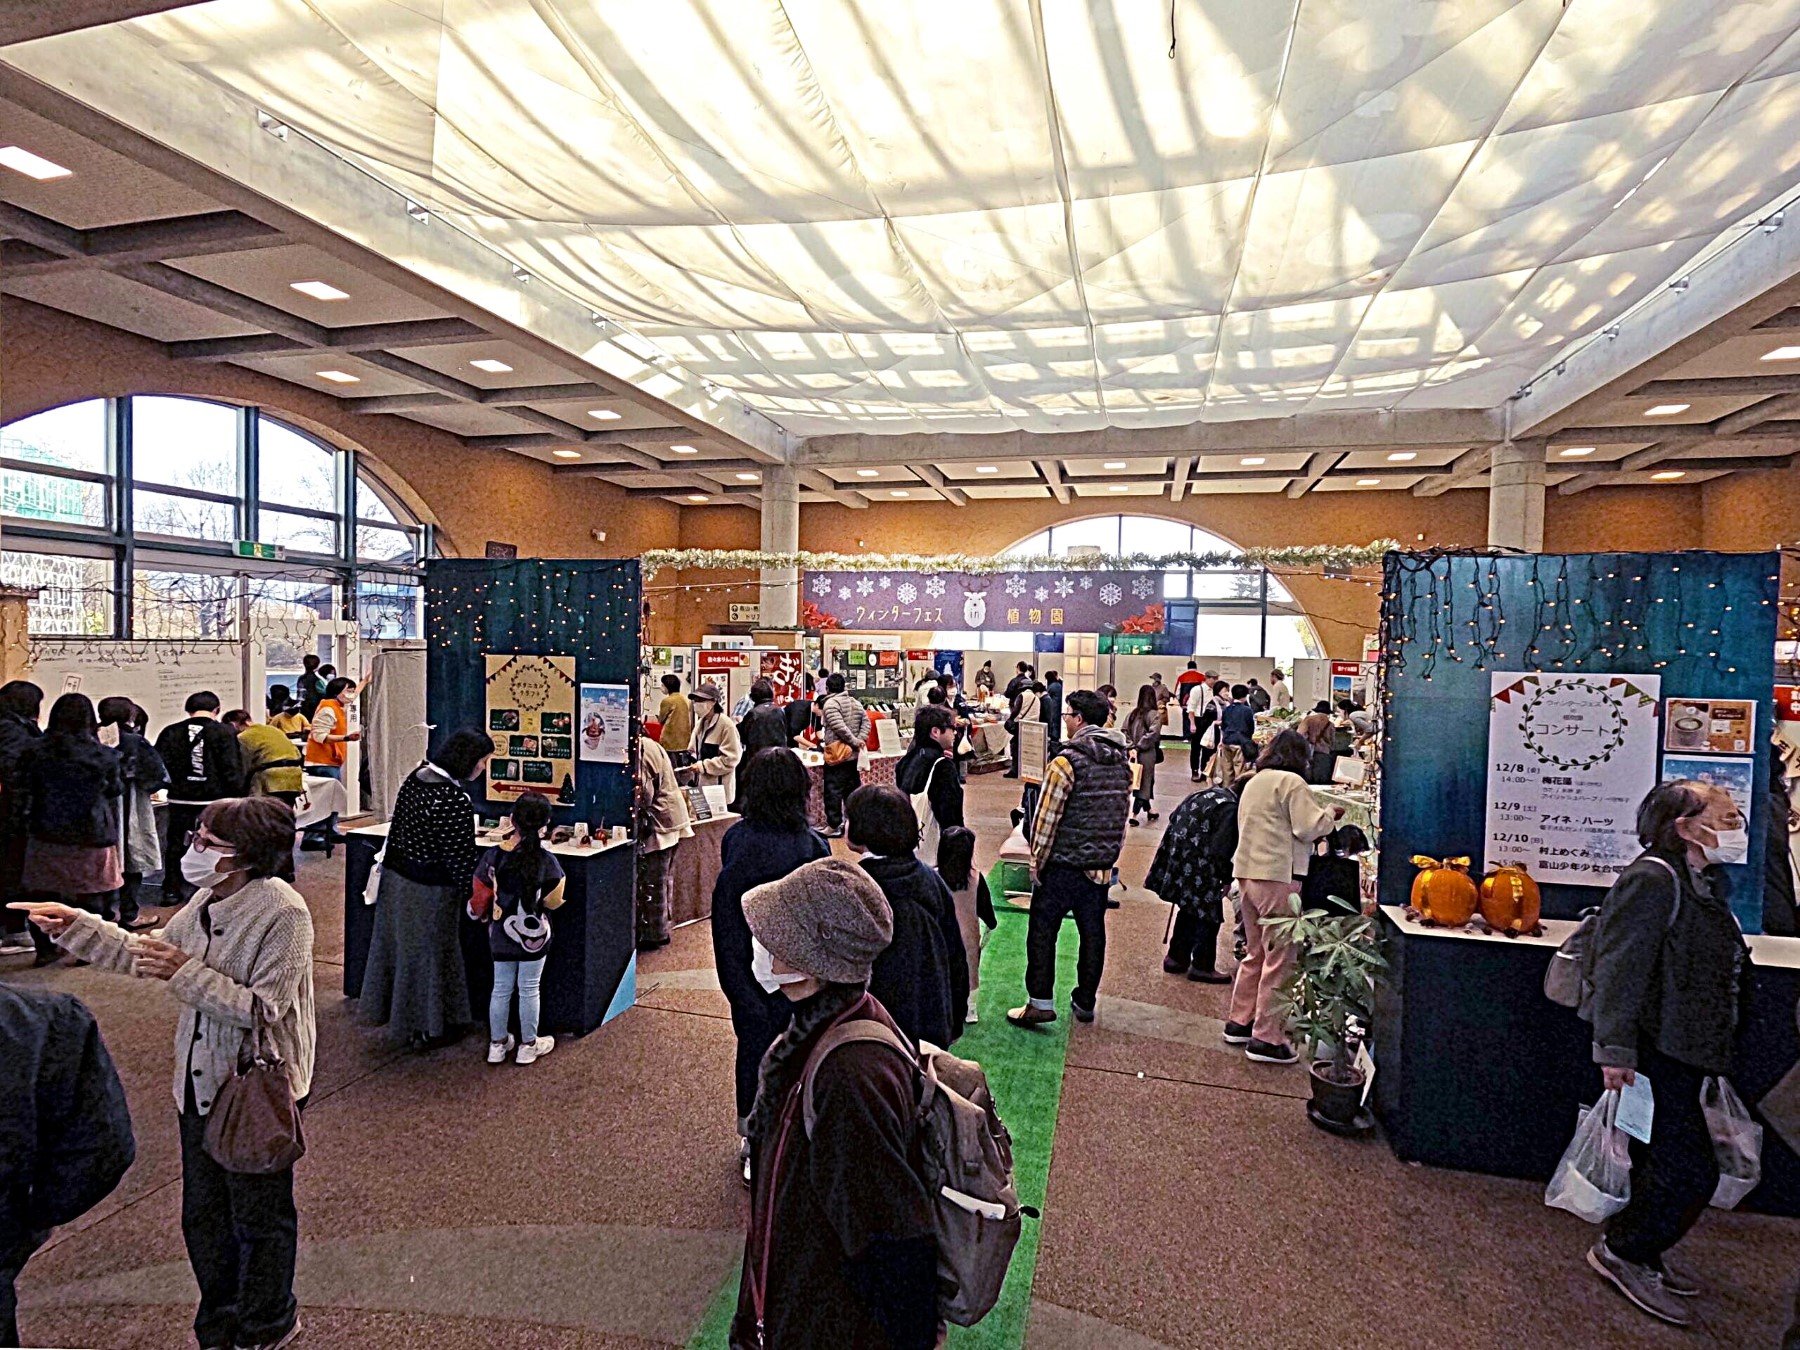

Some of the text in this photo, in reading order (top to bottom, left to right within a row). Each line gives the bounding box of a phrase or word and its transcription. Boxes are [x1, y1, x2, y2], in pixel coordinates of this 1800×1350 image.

[856, 605, 1064, 625] ウィンターフェス in 植物園
[1536, 724, 1610, 737] コンサート
[1495, 763, 1524, 772] 12/8
[1494, 802, 1520, 811] 12/9
[1540, 814, 1614, 826] アイネ・ハーツ
[1493, 833, 1529, 843] 12/10
[1539, 847, 1590, 857] 村上めぐみ
